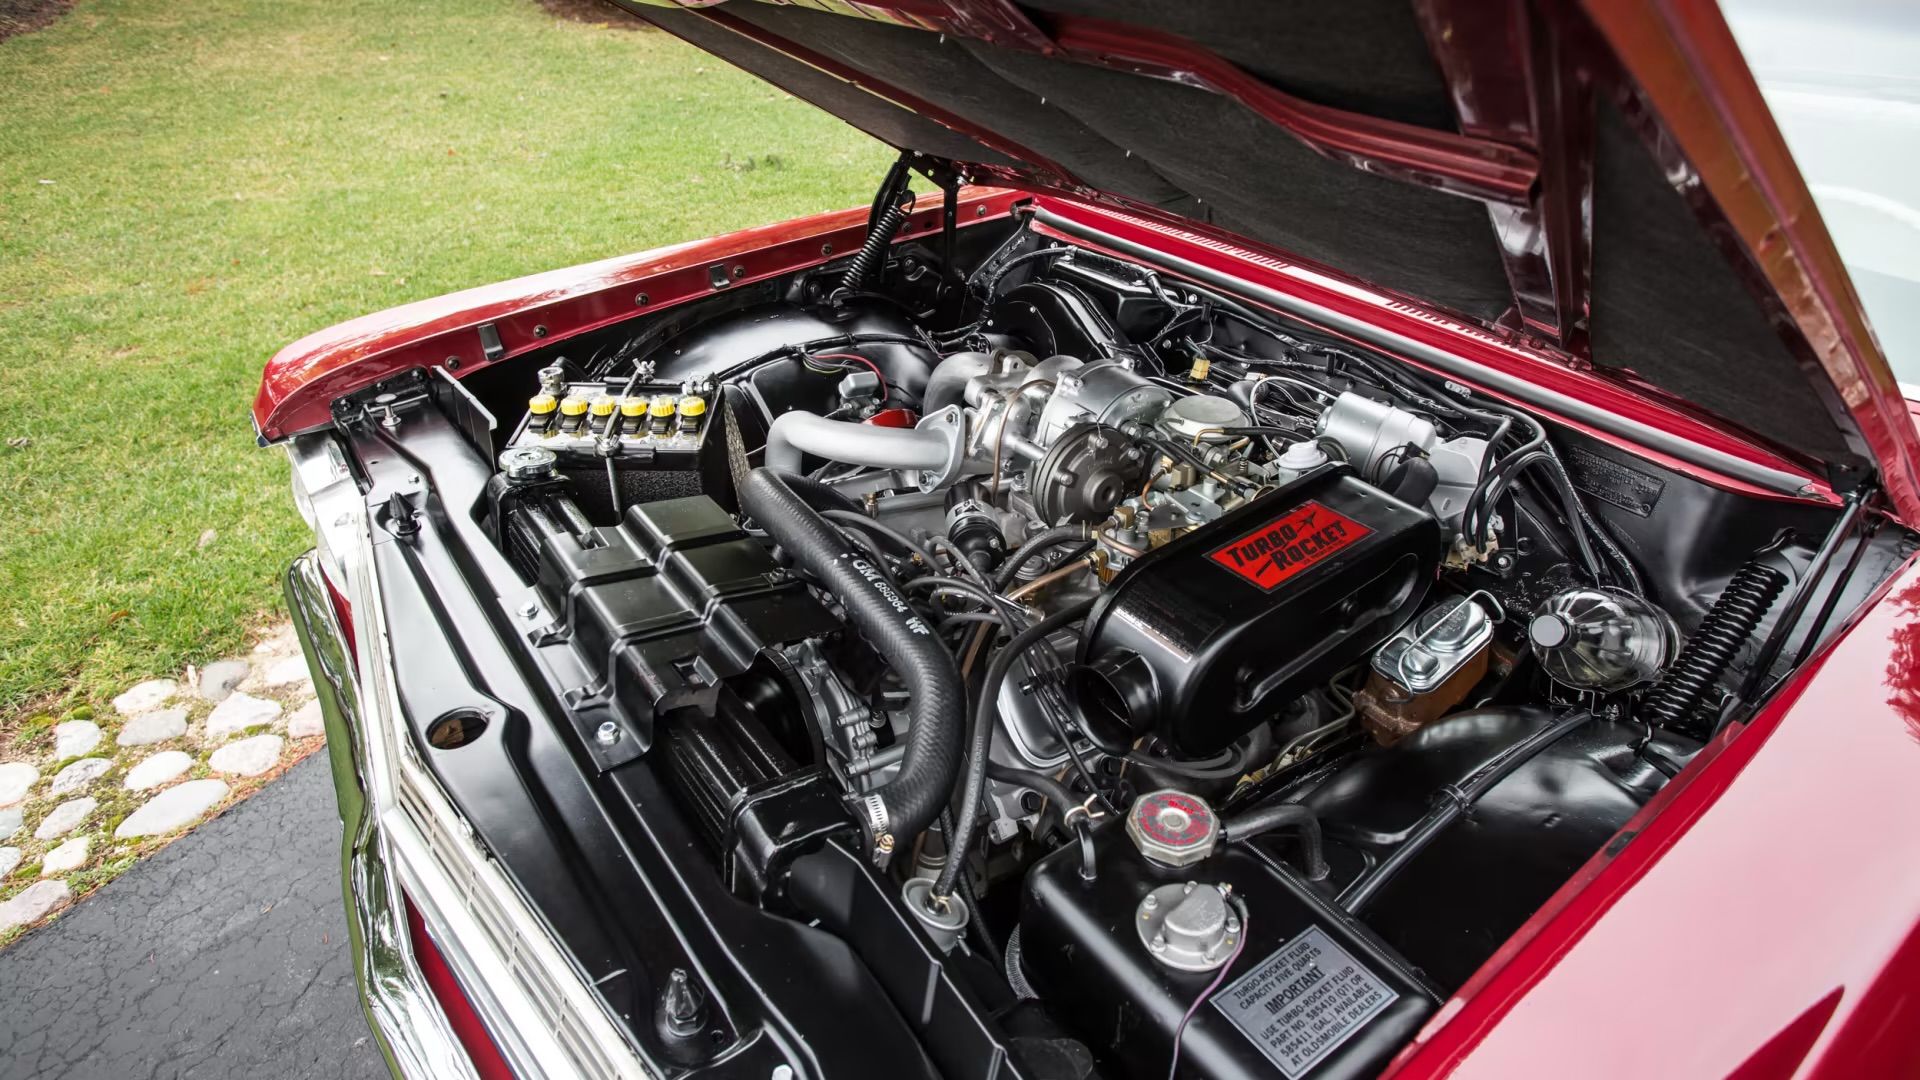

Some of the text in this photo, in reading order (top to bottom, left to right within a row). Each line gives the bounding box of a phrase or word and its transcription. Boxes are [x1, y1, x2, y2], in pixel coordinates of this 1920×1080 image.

[853, 560, 882, 582] GM
[1227, 524, 1298, 567] TURBO
[1271, 520, 1347, 571] ROCKET
[1233, 941, 1311, 999] TURBO-ROCKET FLUID
[1238, 947, 1321, 1010] CAPACITY FIVE QUARTS
[1264, 965, 1325, 1014] IMPORTANT
[1260, 966, 1354, 1040] USE TURBO-ROCKET FLUID
[1270, 1029, 1292, 1048] PART
[1350, 973, 1364, 986] OR
[1334, 983, 1373, 1014] AVAILABLE
[1290, 990, 1382, 1066] AT OLDSMOBILE DEALERS
